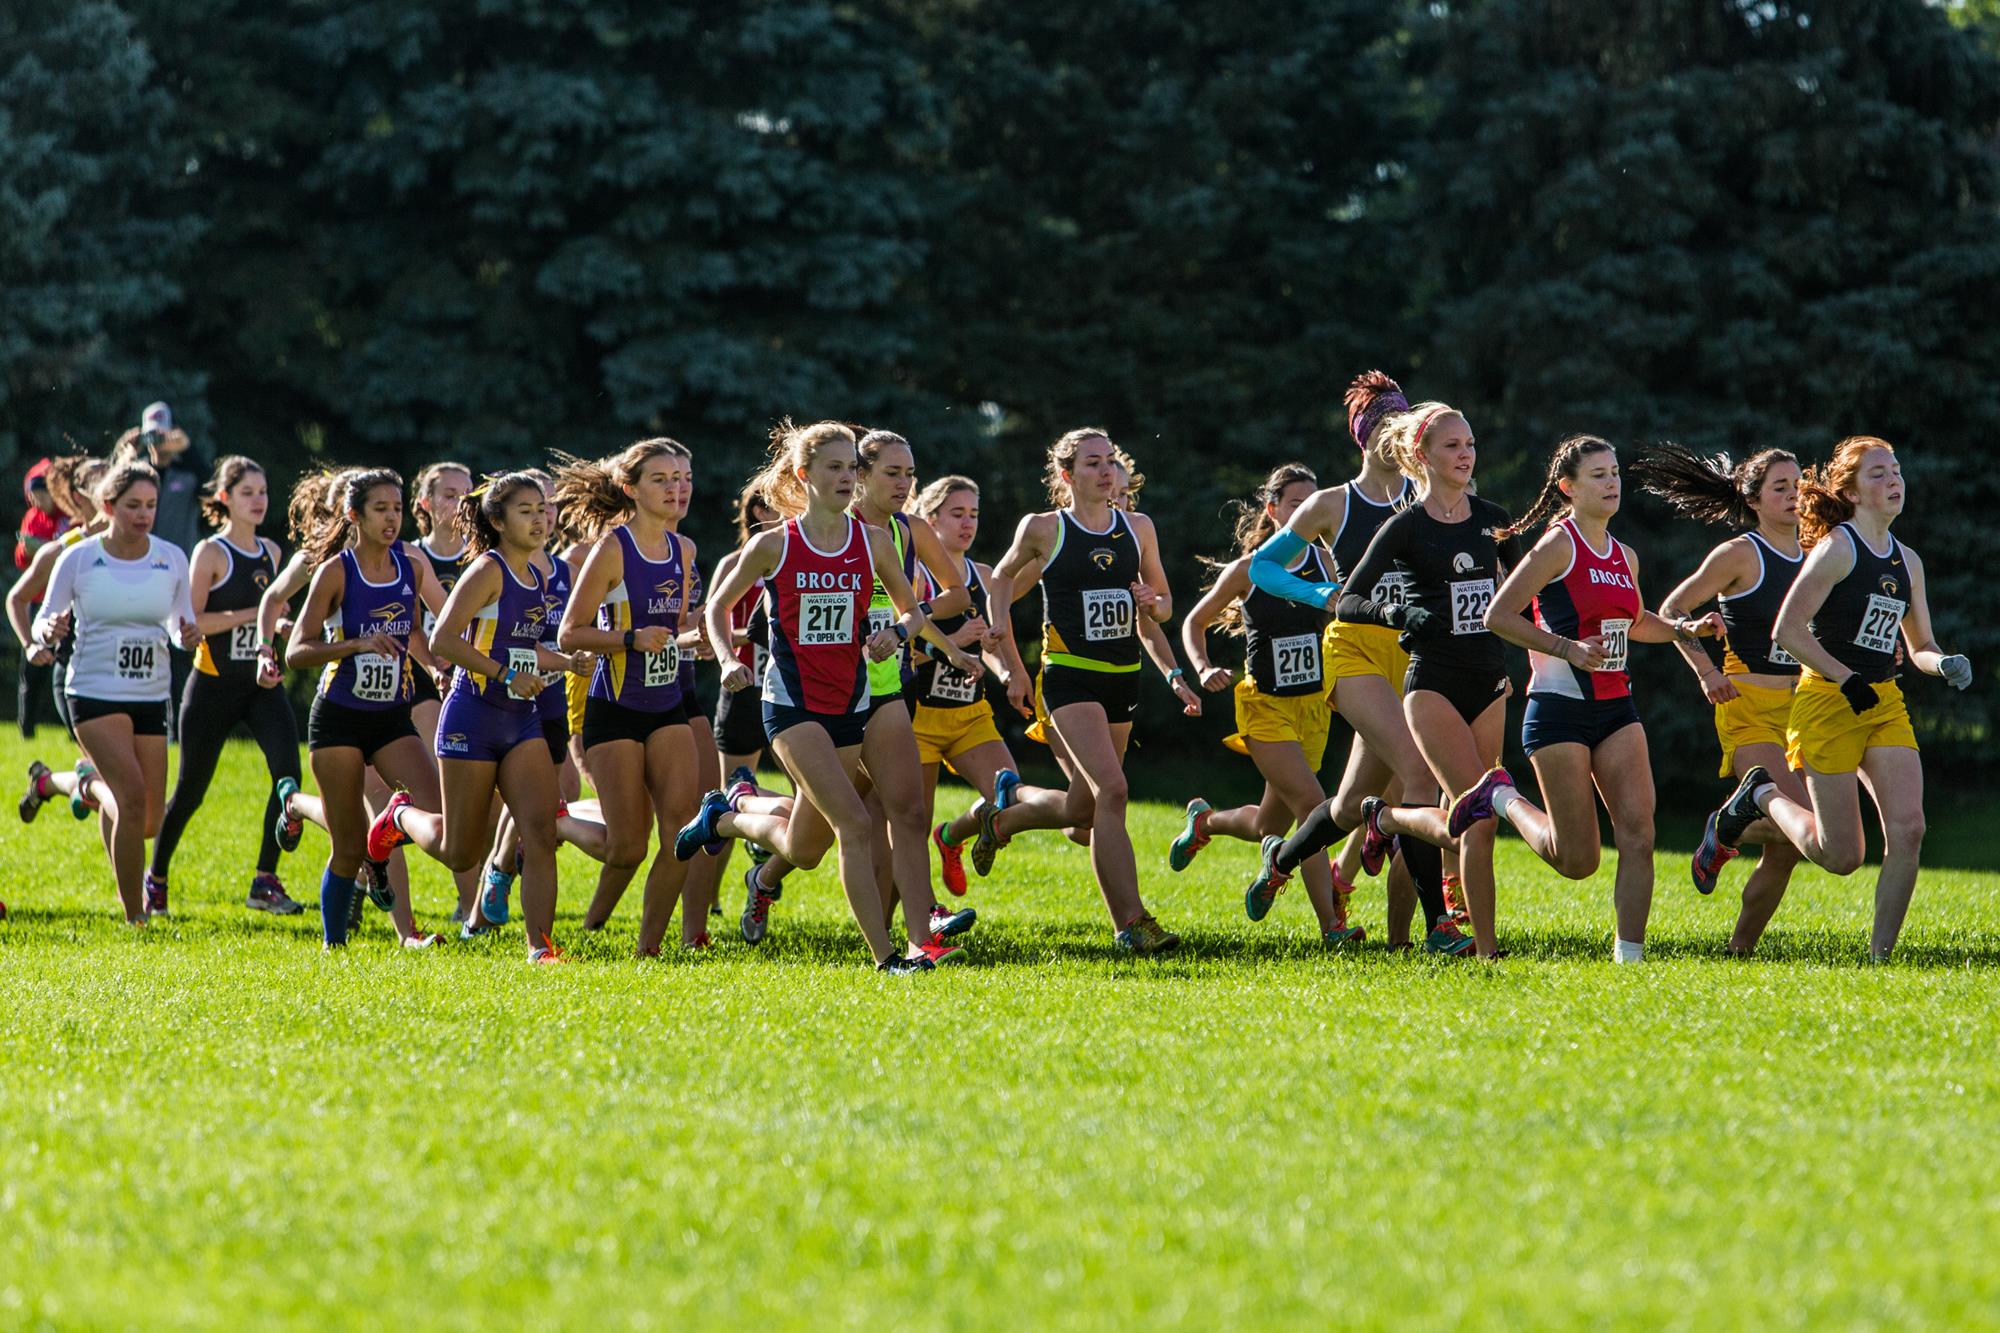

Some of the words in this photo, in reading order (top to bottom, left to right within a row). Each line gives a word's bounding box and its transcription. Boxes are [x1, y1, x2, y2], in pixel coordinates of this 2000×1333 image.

[796, 572, 862, 590] BROCK
[1589, 568, 1634, 590] BROCK
[1376, 584, 1402, 604] 26
[1457, 585, 1490, 593] WATERLOO
[648, 598, 683, 609] LAURIE
[1874, 601, 1901, 611] WATERLOO
[807, 605, 847, 631] 217
[1088, 600, 1129, 628] 260
[360, 620, 411, 635] LAURIER
[1864, 607, 1898, 639] 272
[236, 625, 257, 648] 27
[817, 633, 835, 642] OPEN
[1102, 629, 1118, 638] OPEN
[1278, 639, 1313, 648] WATERLOO
[1869, 638, 1884, 649] OPEN
[119, 646, 154, 669] 304
[648, 646, 677, 674] 296
[1279, 646, 1315, 674] 278
[128, 671, 144, 679] OPEN
[361, 665, 394, 689] 315
[658, 673, 670, 683] OPEN
[1291, 673, 1307, 683] OPEN
[366, 690, 382, 699] OPEN
[946, 689, 962, 698] OPEN
